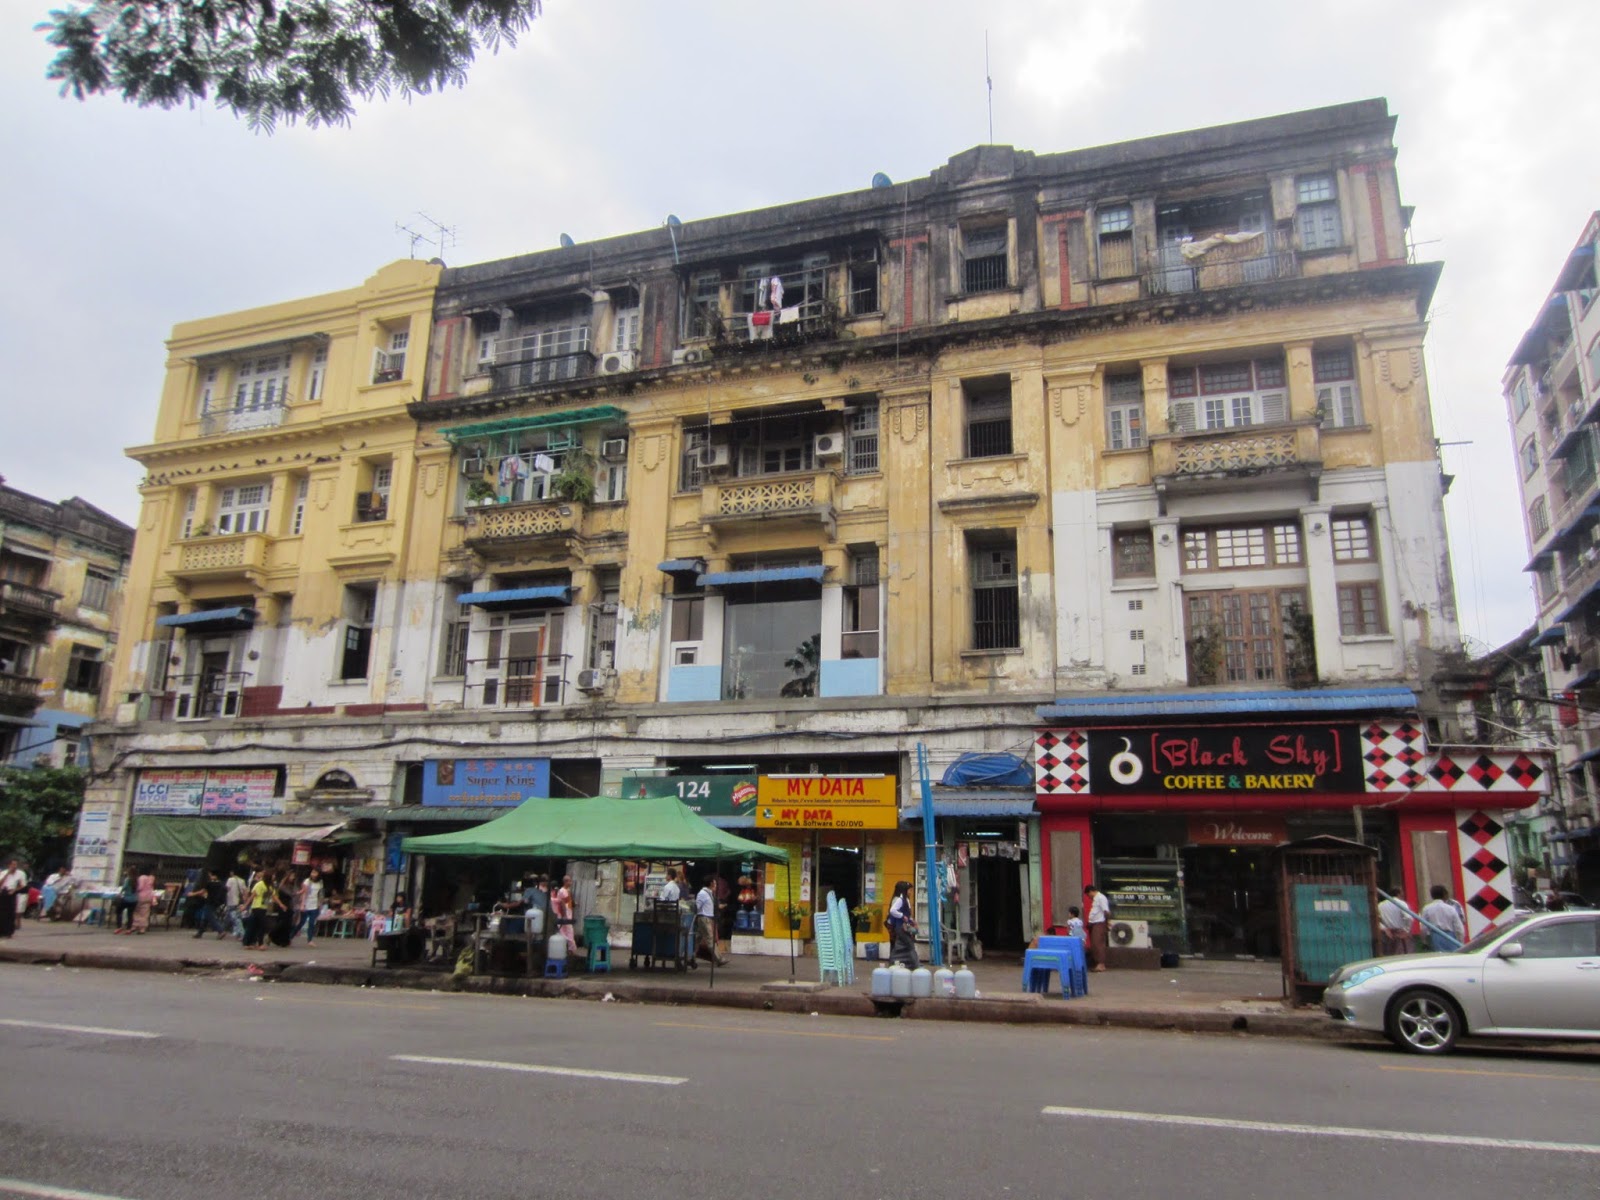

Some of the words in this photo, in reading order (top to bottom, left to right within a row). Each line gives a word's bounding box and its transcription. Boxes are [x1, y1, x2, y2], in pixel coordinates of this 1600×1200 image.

[467, 775, 500, 785] Super
[505, 775, 536, 785] King
[787, 778, 813, 796] MY
[819, 778, 864, 796] DATA
[1164, 775, 1226, 789] COFFEE
[1228, 775, 1241, 789] &
[1245, 774, 1316, 789] BAKERY
[139, 784, 169, 794] LCCI
[677, 781, 711, 798] 124
[781, 809, 799, 820] MY
[803, 809, 833, 820] DATA
[1204, 822, 1273, 840] Welcome
